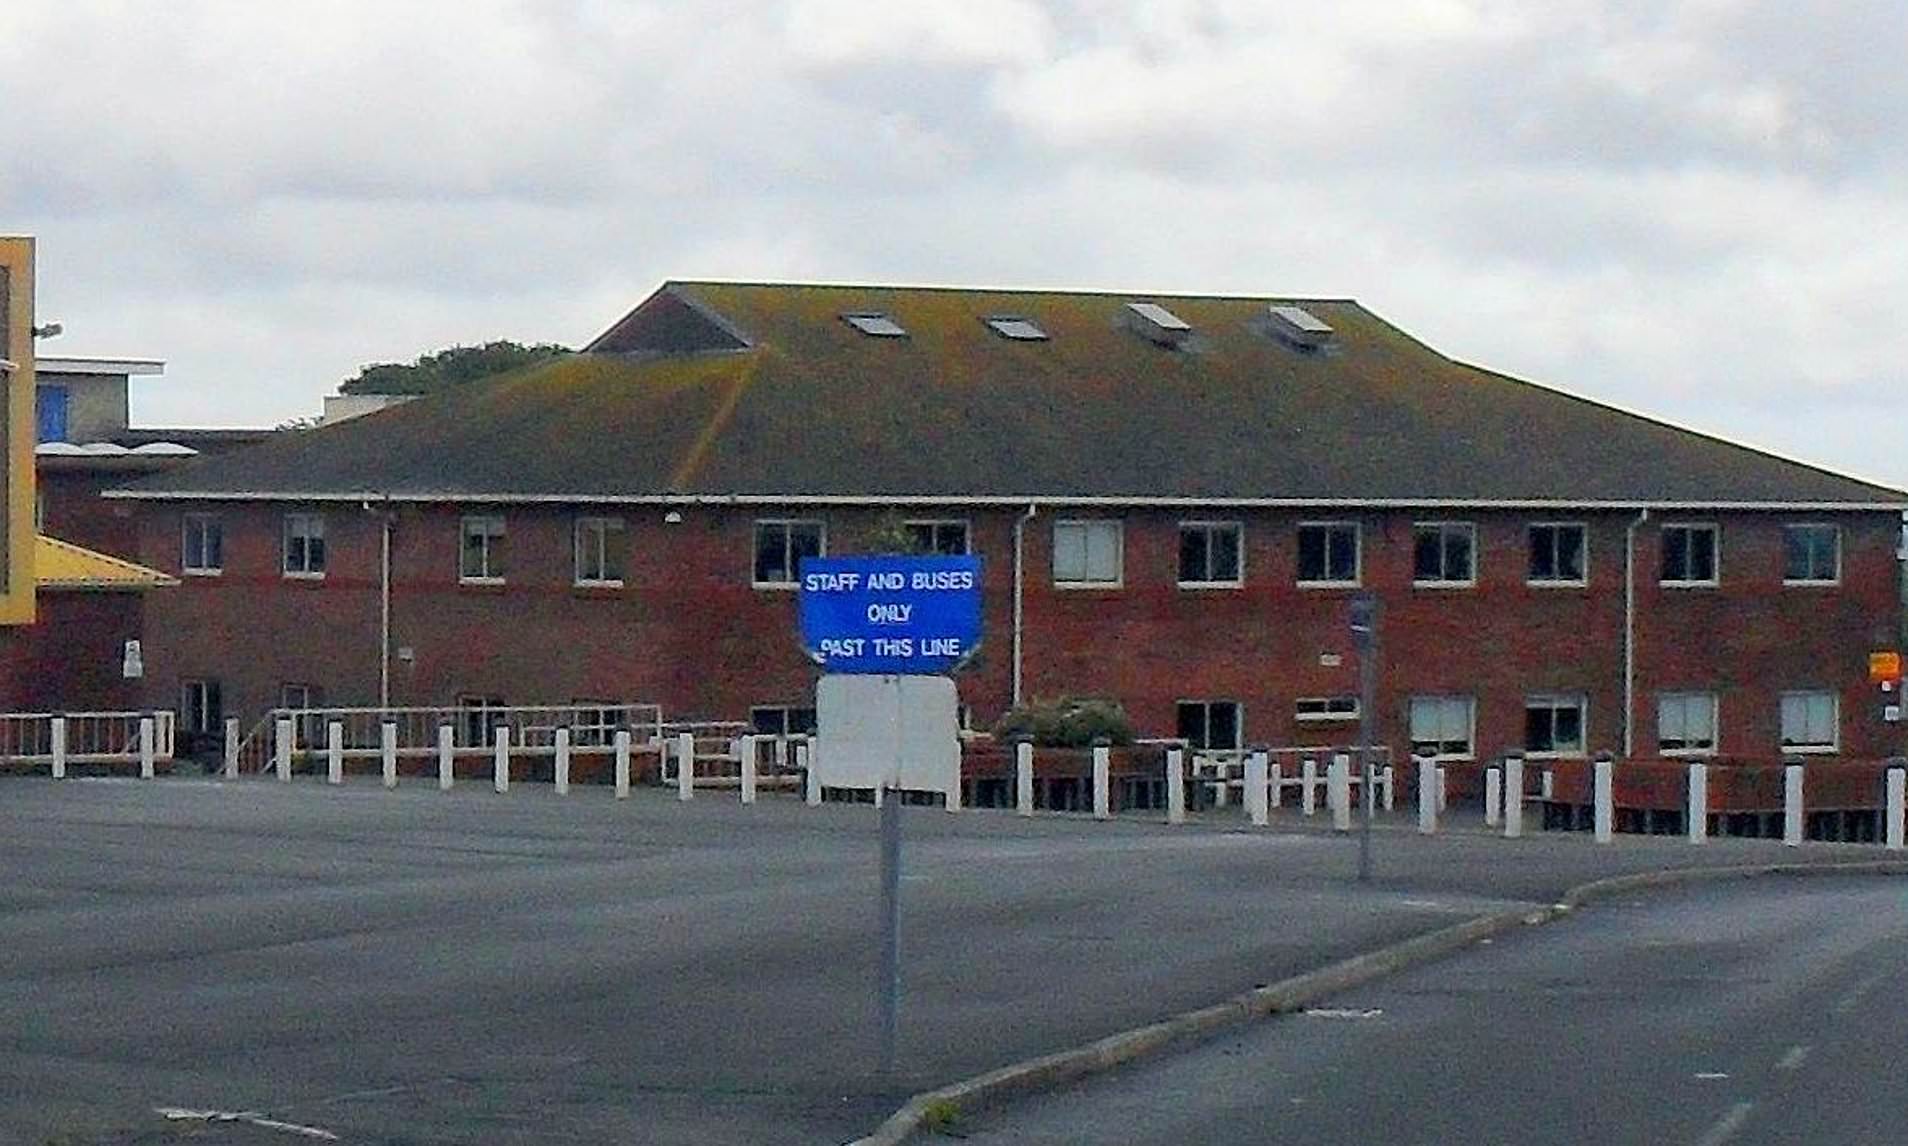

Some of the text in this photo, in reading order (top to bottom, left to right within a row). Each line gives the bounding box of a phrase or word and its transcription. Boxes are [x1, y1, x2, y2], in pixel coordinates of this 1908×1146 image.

[806, 571, 973, 592] STAFF AND BUSES
[867, 603, 913, 622] ONLY
[872, 638, 913, 656] THIS
[921, 638, 960, 656] LINE
